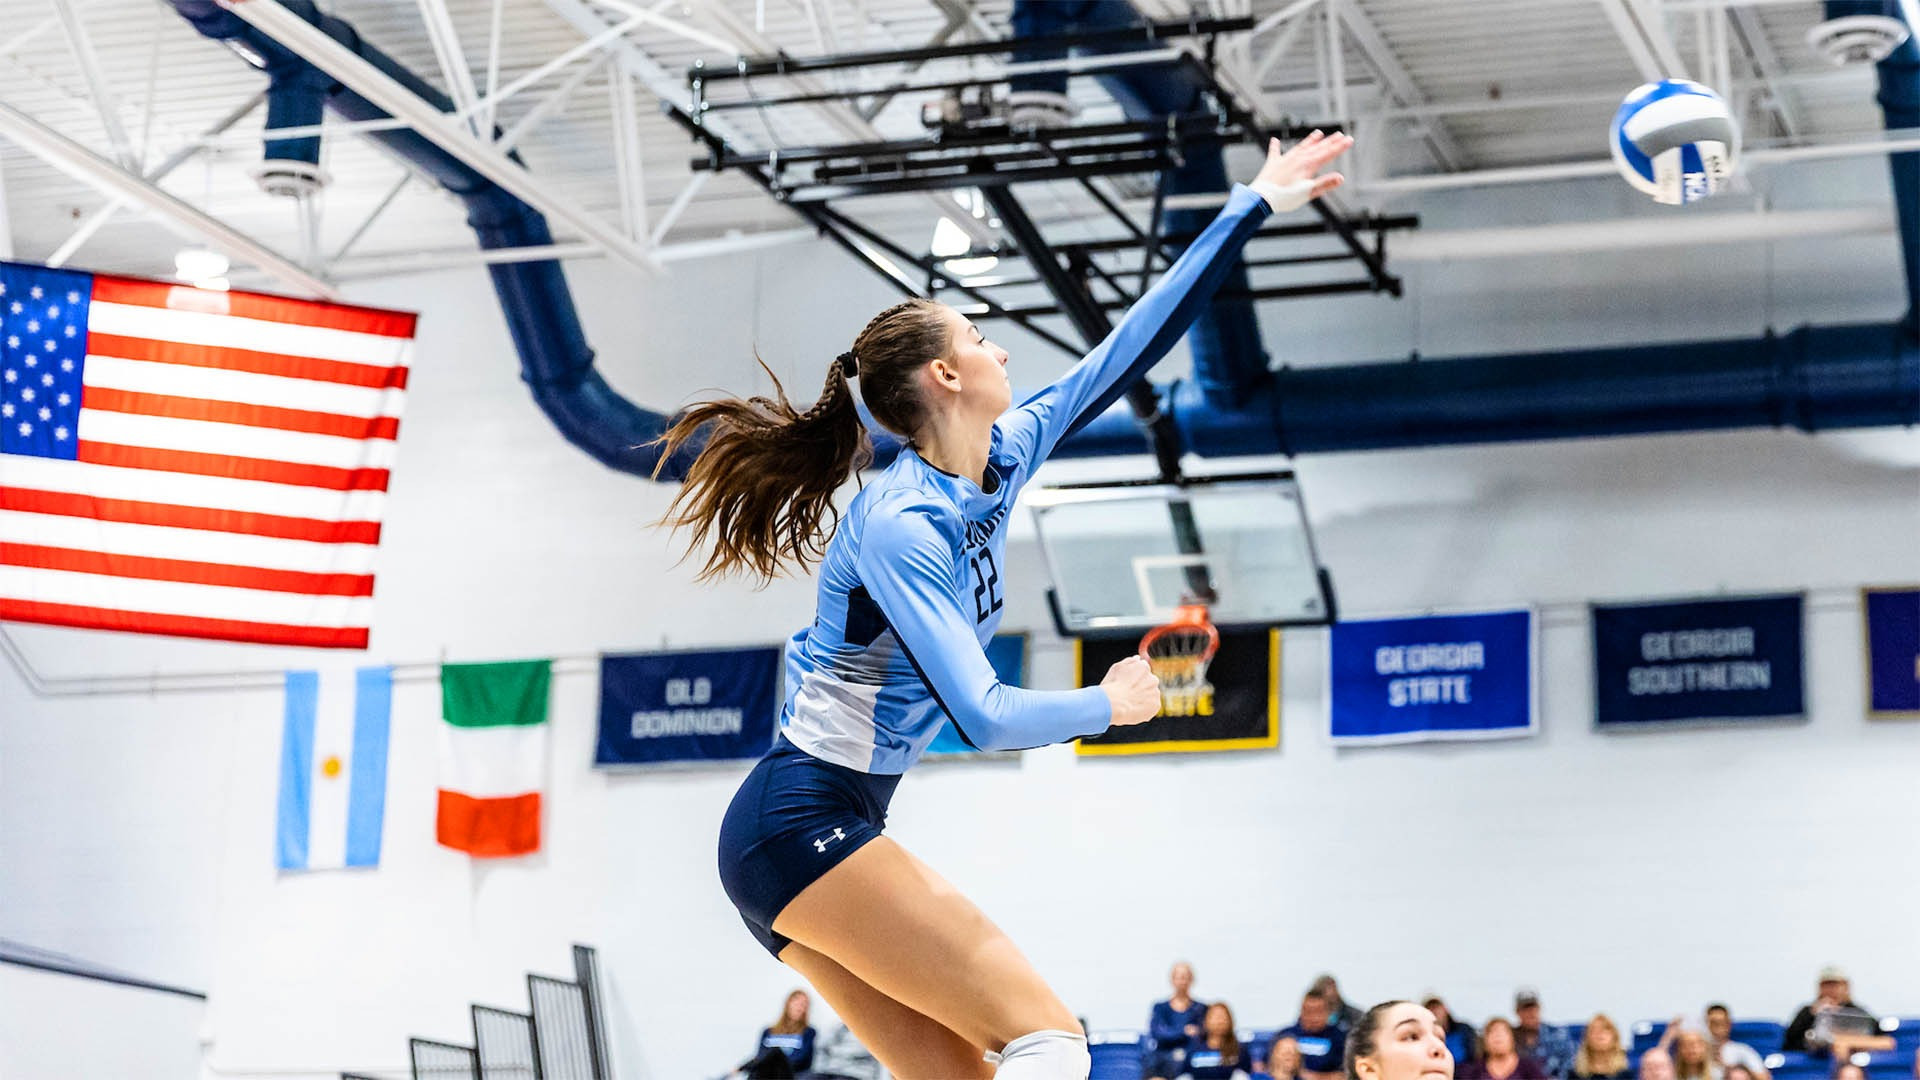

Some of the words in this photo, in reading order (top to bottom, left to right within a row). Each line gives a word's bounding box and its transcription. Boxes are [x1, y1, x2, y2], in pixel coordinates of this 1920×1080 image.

[971, 546, 1003, 625] 22
[1375, 641, 1484, 675] GEORGIA
[1641, 626, 1754, 661] GEORGIA
[665, 677, 711, 706] OLD
[1388, 675, 1472, 707] STATE
[1628, 660, 1771, 695] SOUTHERN
[631, 708, 742, 739] DOMINION
